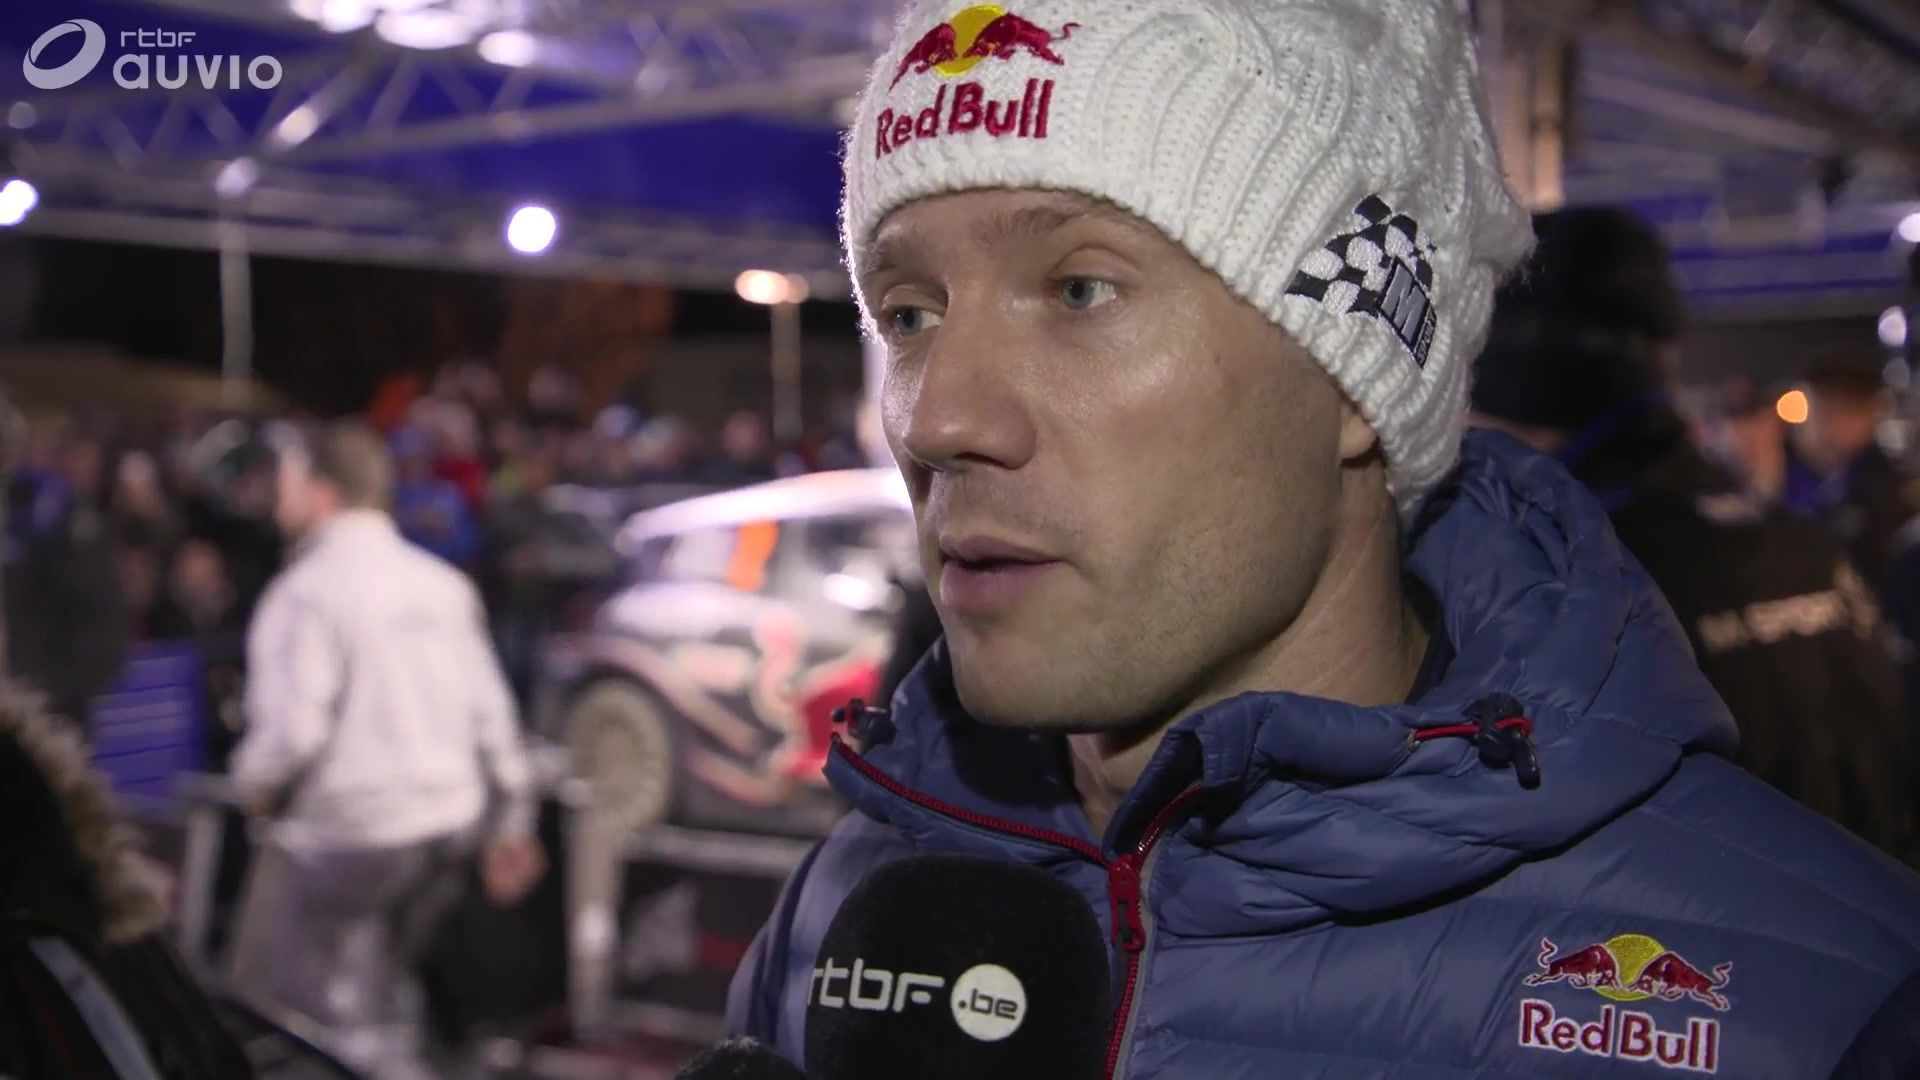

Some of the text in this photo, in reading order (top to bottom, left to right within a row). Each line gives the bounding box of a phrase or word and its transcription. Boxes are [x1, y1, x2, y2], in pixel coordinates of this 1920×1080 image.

[876, 77, 1055, 160] Red Bull
[1519, 998, 1720, 1074] Red Bull
